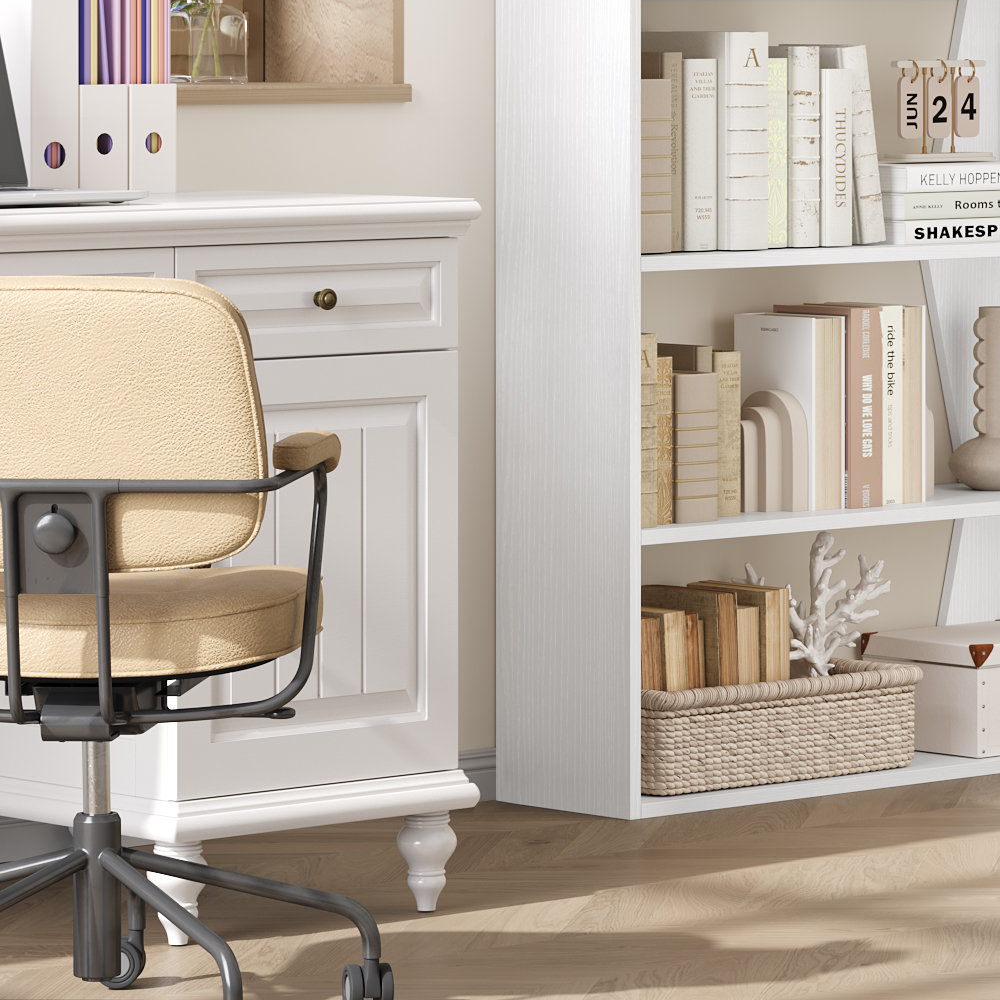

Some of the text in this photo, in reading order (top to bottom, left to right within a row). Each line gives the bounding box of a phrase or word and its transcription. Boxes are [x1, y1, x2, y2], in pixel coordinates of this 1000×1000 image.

[743, 48, 761, 67] A
[906, 93, 918, 129] JUN
[932, 93, 977, 123] 2 4
[835, 108, 847, 208] THUCYDIDES
[920, 173, 956, 186] KELLY
[955, 200, 994, 210] Rooms
[641, 349, 651, 368] A
[887, 325, 895, 396] ride the bike
[862, 375, 873, 458] WHY DO WE LOVE CATS
